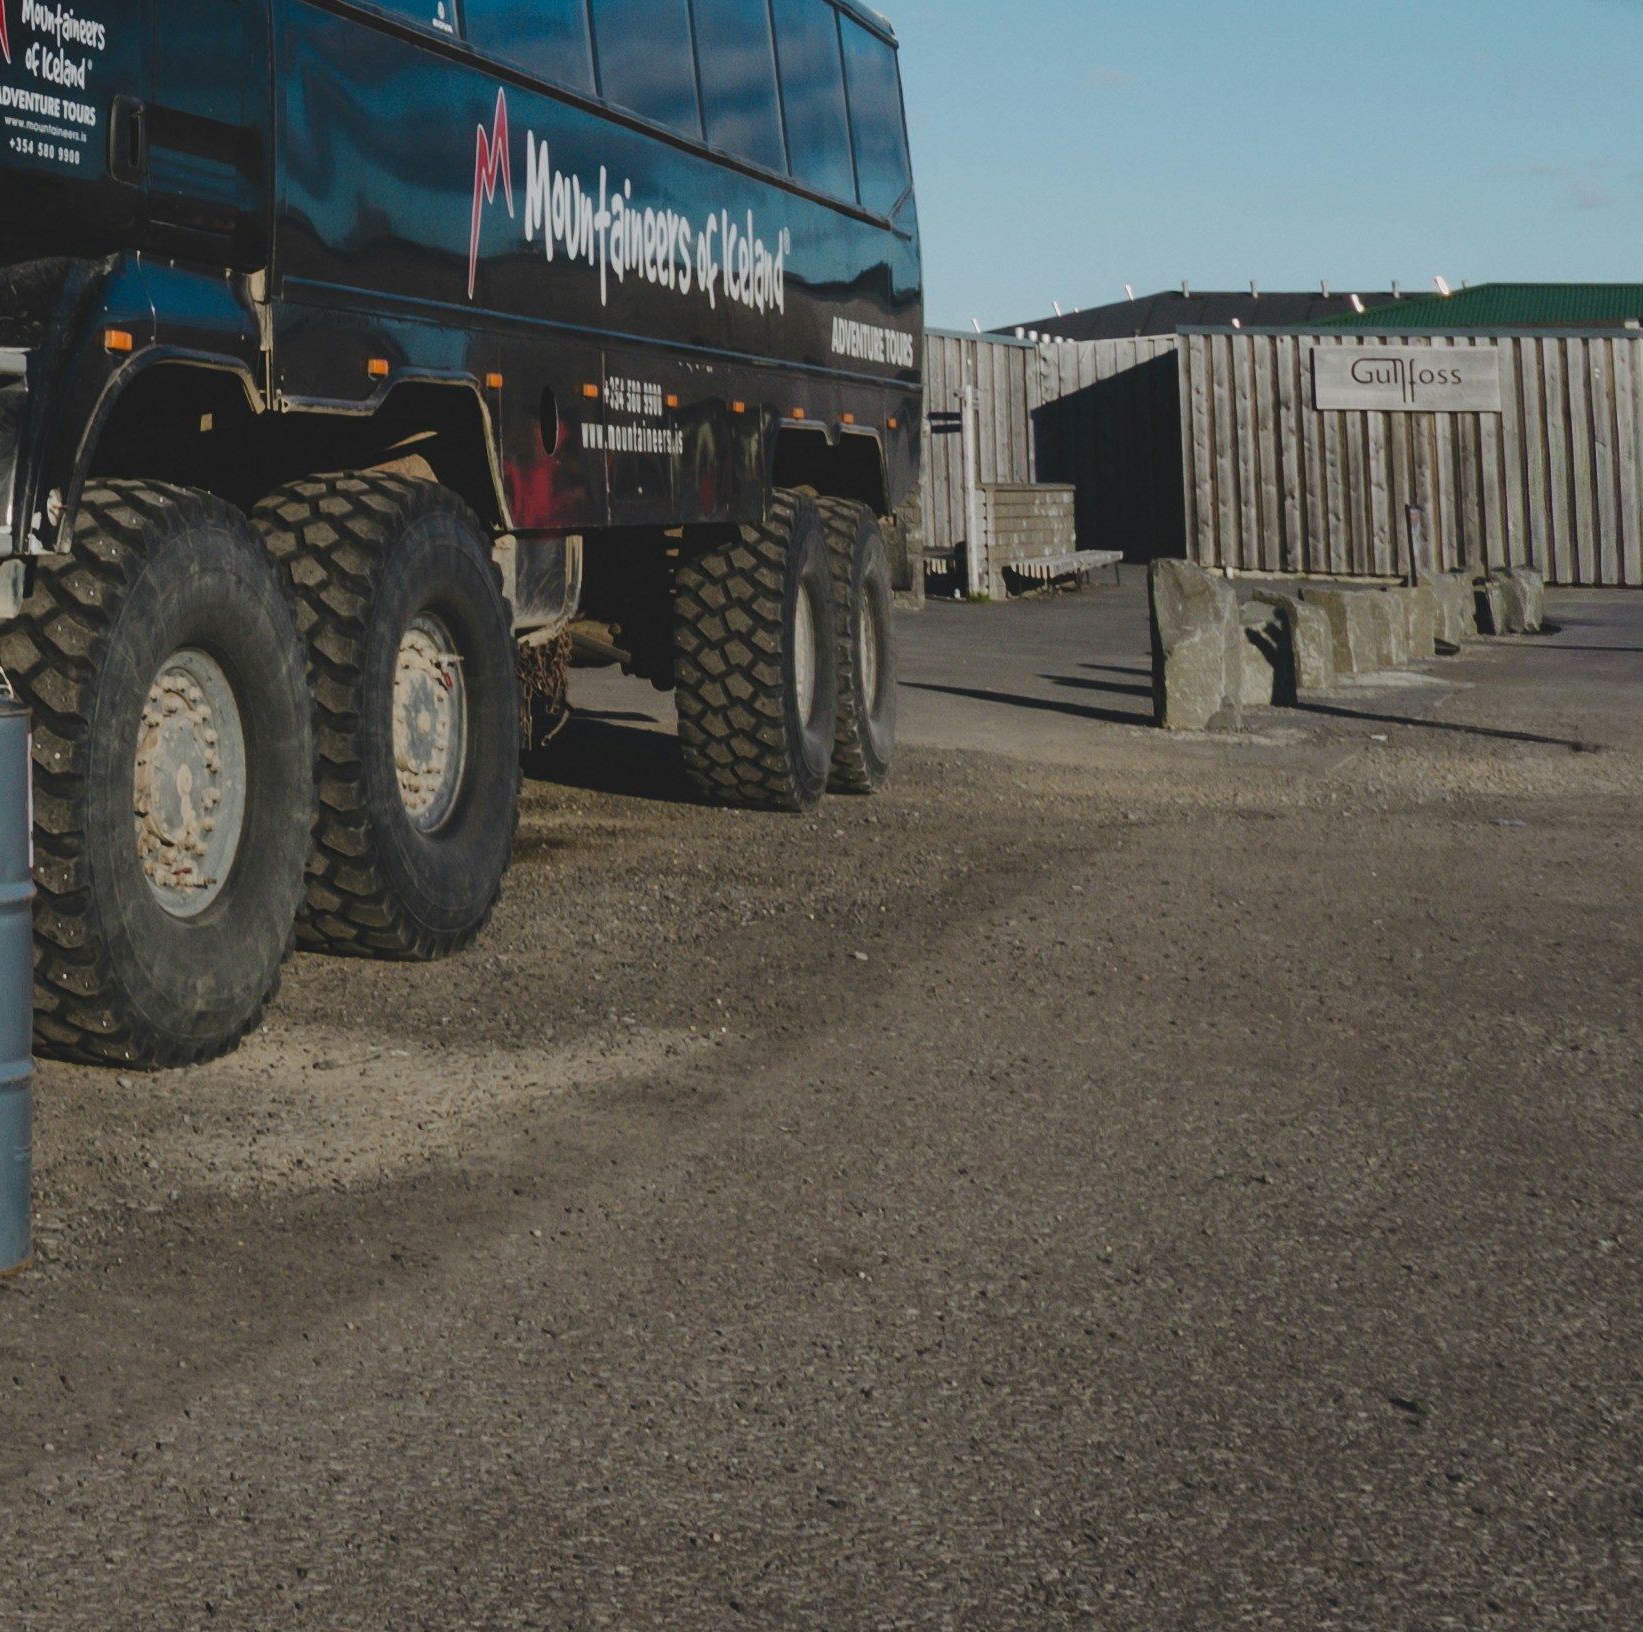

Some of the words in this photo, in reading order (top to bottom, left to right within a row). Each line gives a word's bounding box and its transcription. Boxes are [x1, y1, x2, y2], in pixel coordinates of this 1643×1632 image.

[25, 42, 41, 77] of
[4, 116, 88, 143] www.mountaineers.is
[63, 99, 97, 127] TOURS
[9, 137, 34, 155] +354
[37, 142, 55, 159] 580
[58, 147, 80, 165] 9900
[524, 129, 692, 307] Mountaineers
[696, 212, 718, 310] of
[831, 316, 885, 363] ADVENTURE
[884, 328, 914, 368] TOURS
[1351, 357, 1462, 403] Gullfoss
